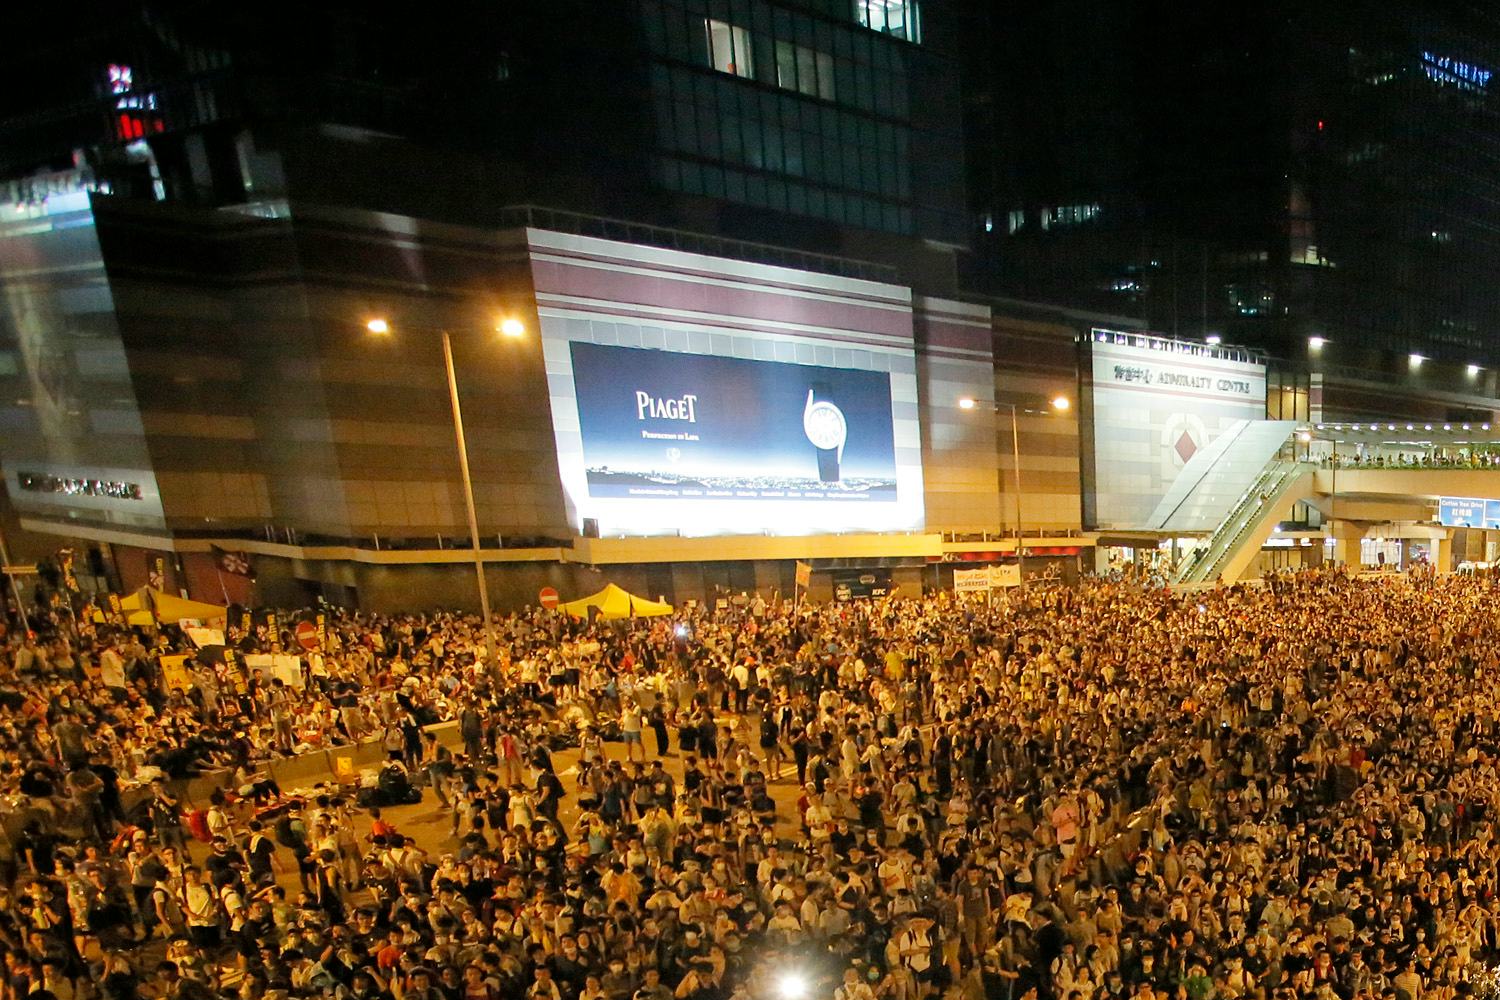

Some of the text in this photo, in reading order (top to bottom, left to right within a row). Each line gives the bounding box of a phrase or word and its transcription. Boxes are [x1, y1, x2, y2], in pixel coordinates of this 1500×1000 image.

[1158, 372, 1250, 394] ADMIRALTY CENTRE
[636, 391, 697, 423] PIAGET
